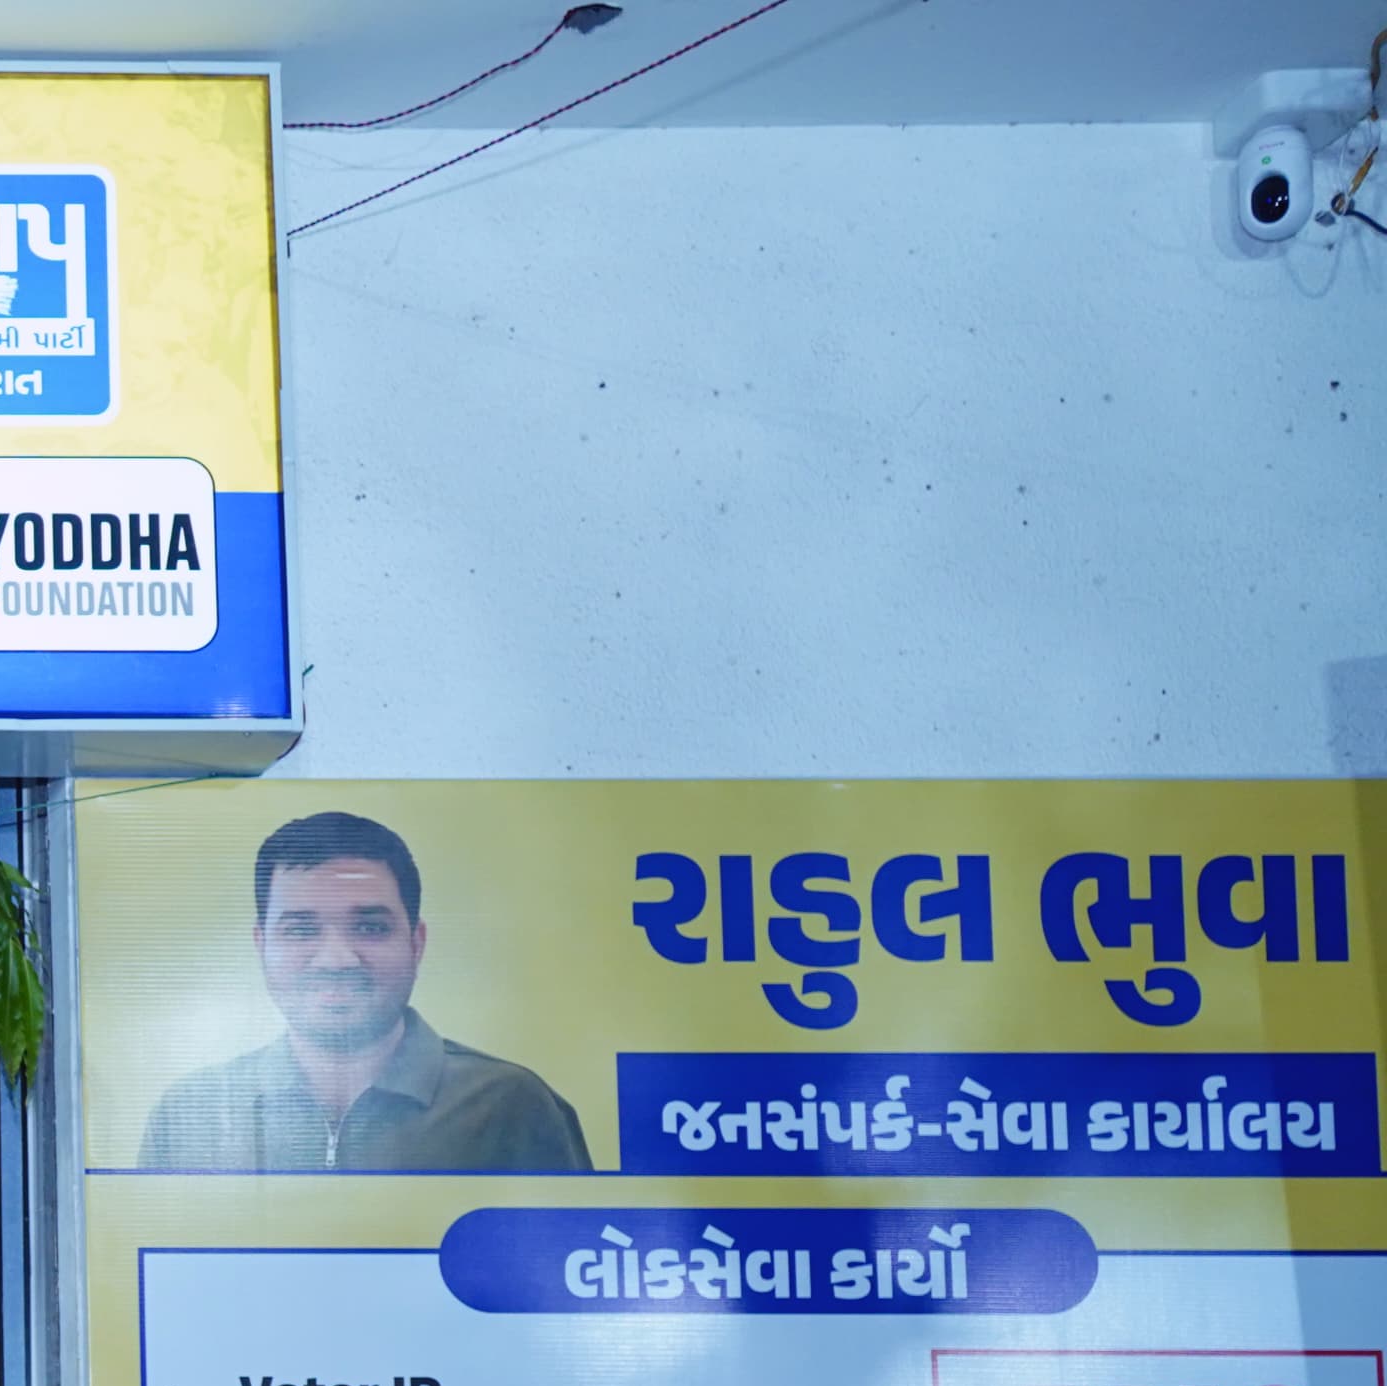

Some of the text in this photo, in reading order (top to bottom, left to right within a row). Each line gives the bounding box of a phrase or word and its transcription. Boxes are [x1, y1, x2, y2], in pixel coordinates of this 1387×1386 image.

[34, 325, 87, 349] પાર્ટી
[632, 850, 1350, 1030] રાહુલ ભુવા
[661, 1074, 1337, 1154] જનસંપર્ક-સેવા કાર્યાલય
[564, 1224, 970, 1301] લોકસેવા કાર્યો
